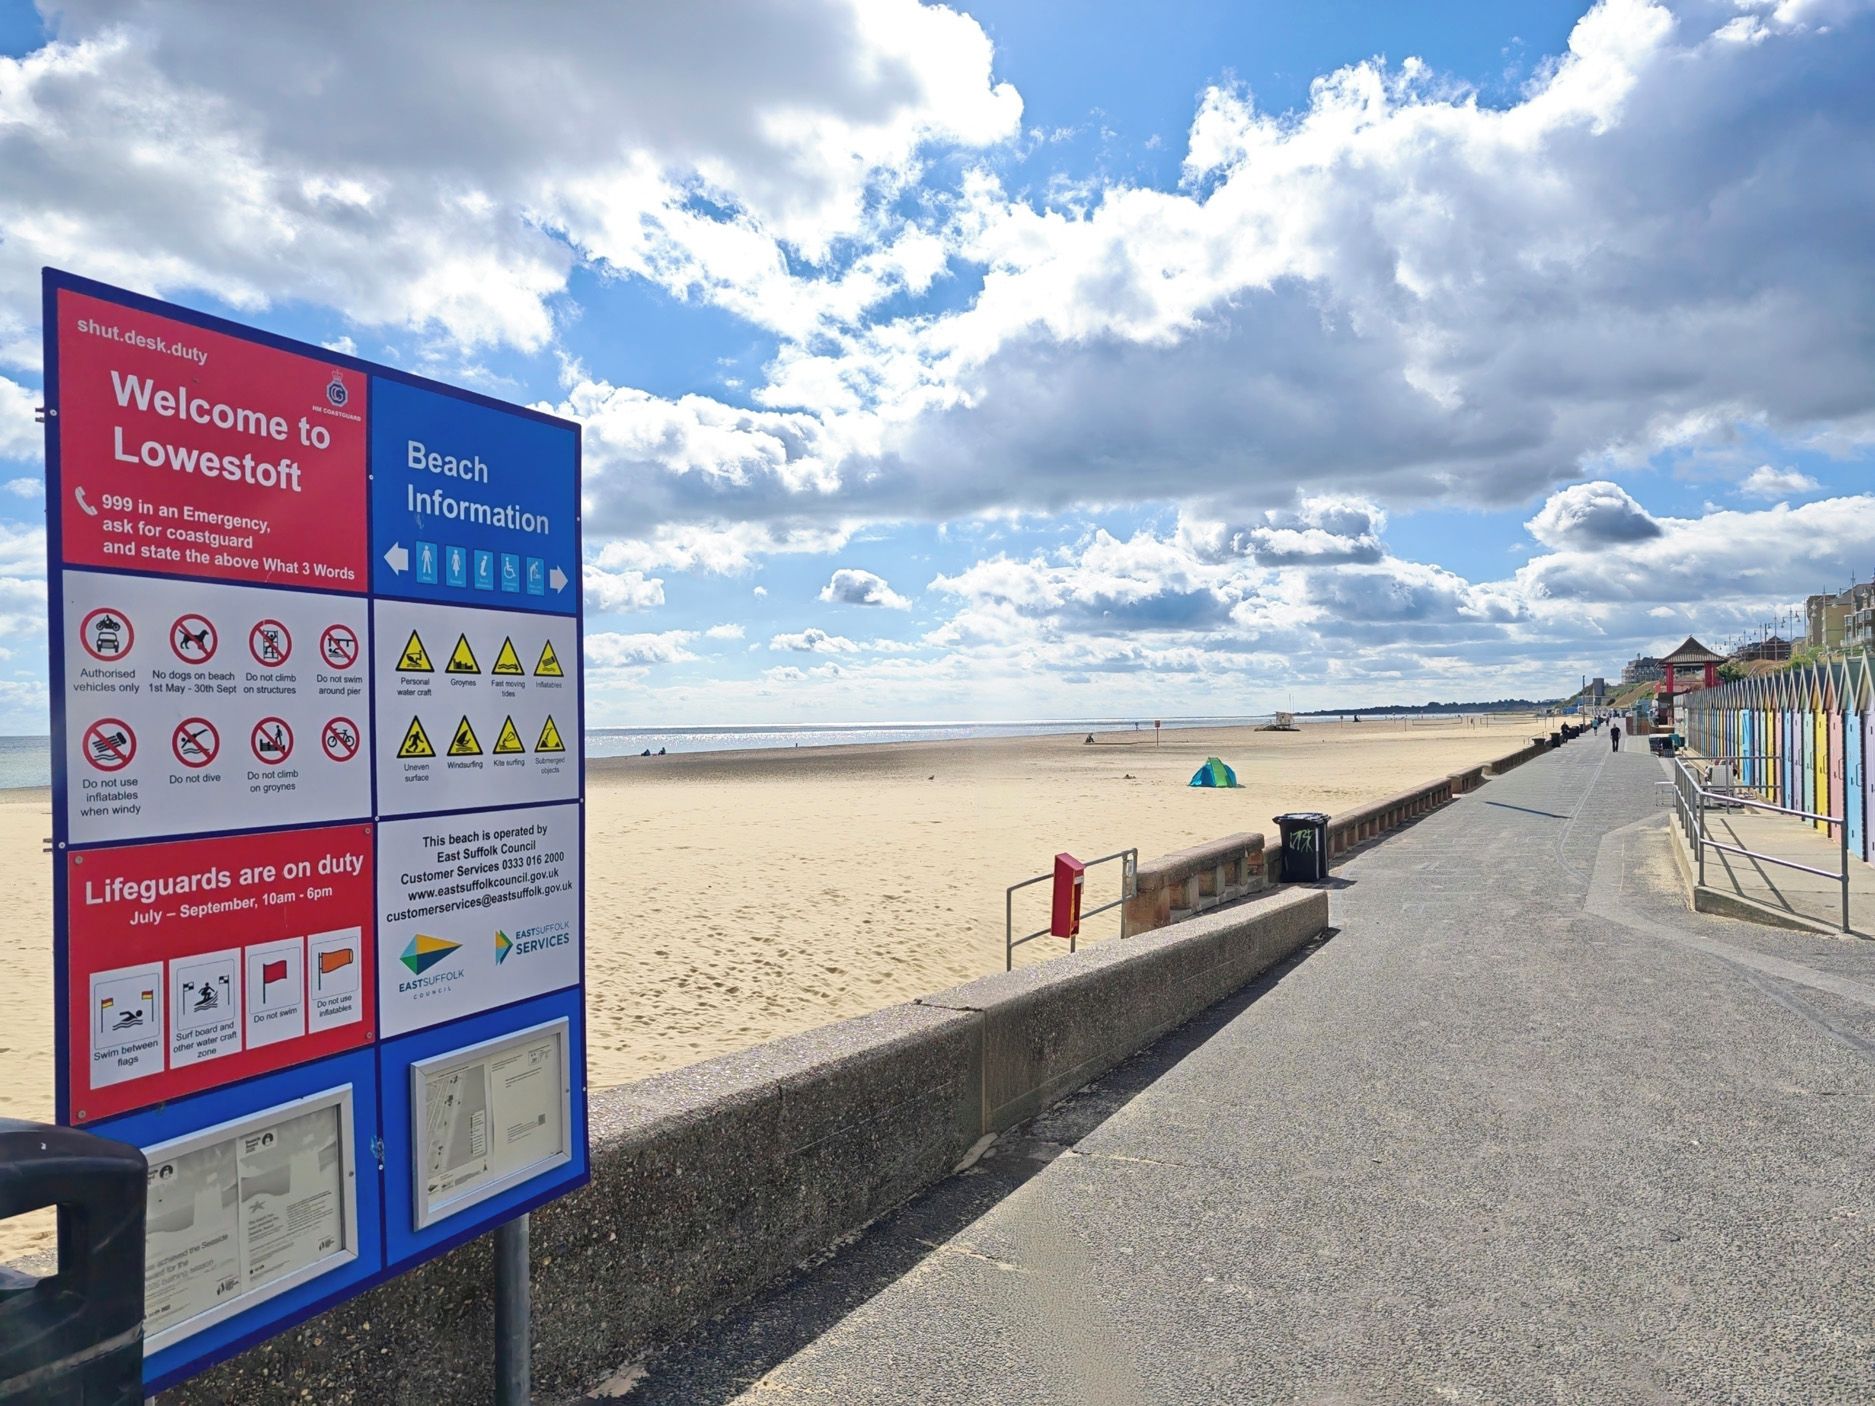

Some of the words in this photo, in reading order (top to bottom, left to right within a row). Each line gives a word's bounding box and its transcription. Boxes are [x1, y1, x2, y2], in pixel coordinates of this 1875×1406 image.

[77, 318, 208, 366] shut.desk.duty
[110, 370, 288, 440] Welcome
[299, 416, 331, 449] to
[323, 408, 361, 421] COASTGUARD
[114, 426, 302, 492] Lowestoft
[408, 440, 488, 483] Beach
[102, 494, 133, 512] 999
[138, 499, 154, 514] in
[158, 504, 178, 518] an
[183, 506, 271, 534] Emergency,
[408, 484, 549, 534] Information
[103, 517, 133, 534] ask
[138, 521, 162, 537] for
[166, 526, 253, 549] coastguard
[103, 540, 136, 555] and
[141, 544, 181, 561] state
[185, 549, 209, 564] the
[214, 553, 259, 570] above
[263, 557, 299, 574] What
[302, 562, 310, 575] 3
[313, 563, 355, 580] Words
[80, 668, 136, 679] Authorised
[152, 670, 166, 679] No
[169, 671, 191, 681] dogs
[194, 672, 205, 680] on
[209, 672, 235, 681] beach
[246, 673, 258, 681] Do
[275, 674, 296, 682] climb
[317, 674, 328, 683] Do
[330, 675, 342, 683] not
[401, 677, 430, 685] Personal
[451, 679, 476, 688] Groynes
[505, 680, 525, 688] moving
[536, 681, 562, 689] Inflatables
[73, 682, 116, 692] vehicles
[119, 683, 140, 694] only
[149, 683, 163, 692] 1st
[166, 683, 185, 694] May
[194, 684, 214, 693] 30th
[217, 684, 237, 694] Sept
[243, 686, 254, 694] on
[256, 686, 296, 694] structures
[347, 687, 361, 696] pier
[448, 761, 483, 769] Windsurfing
[506, 759, 525, 767] surfing
[535, 757, 565, 765] Submerged
[404, 764, 430, 772] Uneven
[169, 775, 183, 784] Do
[186, 775, 200, 783] not
[203, 773, 221, 782] dive
[247, 771, 259, 780] Do
[262, 771, 275, 779] not
[278, 770, 298, 778] climb
[405, 774, 429, 782] surface
[83, 779, 98, 789] Do
[101, 779, 117, 788] not
[120, 778, 138, 787] use
[250, 784, 261, 793] on
[263, 783, 296, 793] groynes
[86, 791, 138, 802] inflatables
[81, 806, 109, 816] when
[112, 804, 141, 815] windy
[423, 836, 446, 848] This
[449, 832, 480, 844] beach
[482, 830, 491, 841] is
[494, 825, 535, 841] operated
[537, 824, 548, 835] by
[437, 852, 460, 863] East
[463, 844, 498, 859] Suffolk
[501, 840, 536, 854] Council
[400, 869, 454, 885] Customer
[457, 862, 499, 877] Services
[502, 858, 524, 869] 0333
[526, 855, 542, 866] 016
[544, 852, 565, 863] 2000
[86, 868, 232, 906] Lifeguards
[239, 865, 276, 886] are
[283, 860, 311, 880] on
[318, 852, 364, 876] duty
[408, 867, 559, 901] www.eastsuffolkcouncil.gov.uk
[130, 910, 162, 926] July
[180, 896, 258, 920] September,
[262, 892, 296, 906] 10am
[307, 886, 332, 900] 6pm
[386, 880, 573, 923] customerservices@eastsuffolk.gov.uk
[516, 921, 570, 940] EASTSUFFOLK
[516, 932, 570, 955] SERVICES
[399, 969, 464, 993] EASTSUFFOLK
[413, 986, 452, 1000] COUNCIL
[317, 1000, 326, 1008] Do
[328, 998, 339, 1006] not
[254, 1015, 264, 1023] Do
[266, 1012, 278, 1020] not
[280, 1007, 297, 1017] swim
[319, 1004, 352, 1018] inflatables
[176, 1030, 193, 1041] Surf
[195, 1025, 218, 1037] board
[220, 1021, 234, 1032] and
[173, 1043, 195, 1053] other
[196, 1038, 218, 1047] water
[220, 1031, 237, 1042] craft
[94, 1048, 119, 1061] Swim
[122, 1040, 158, 1055] between
[197, 1048, 217, 1058] zone
[118, 1056, 139, 1067] flags
